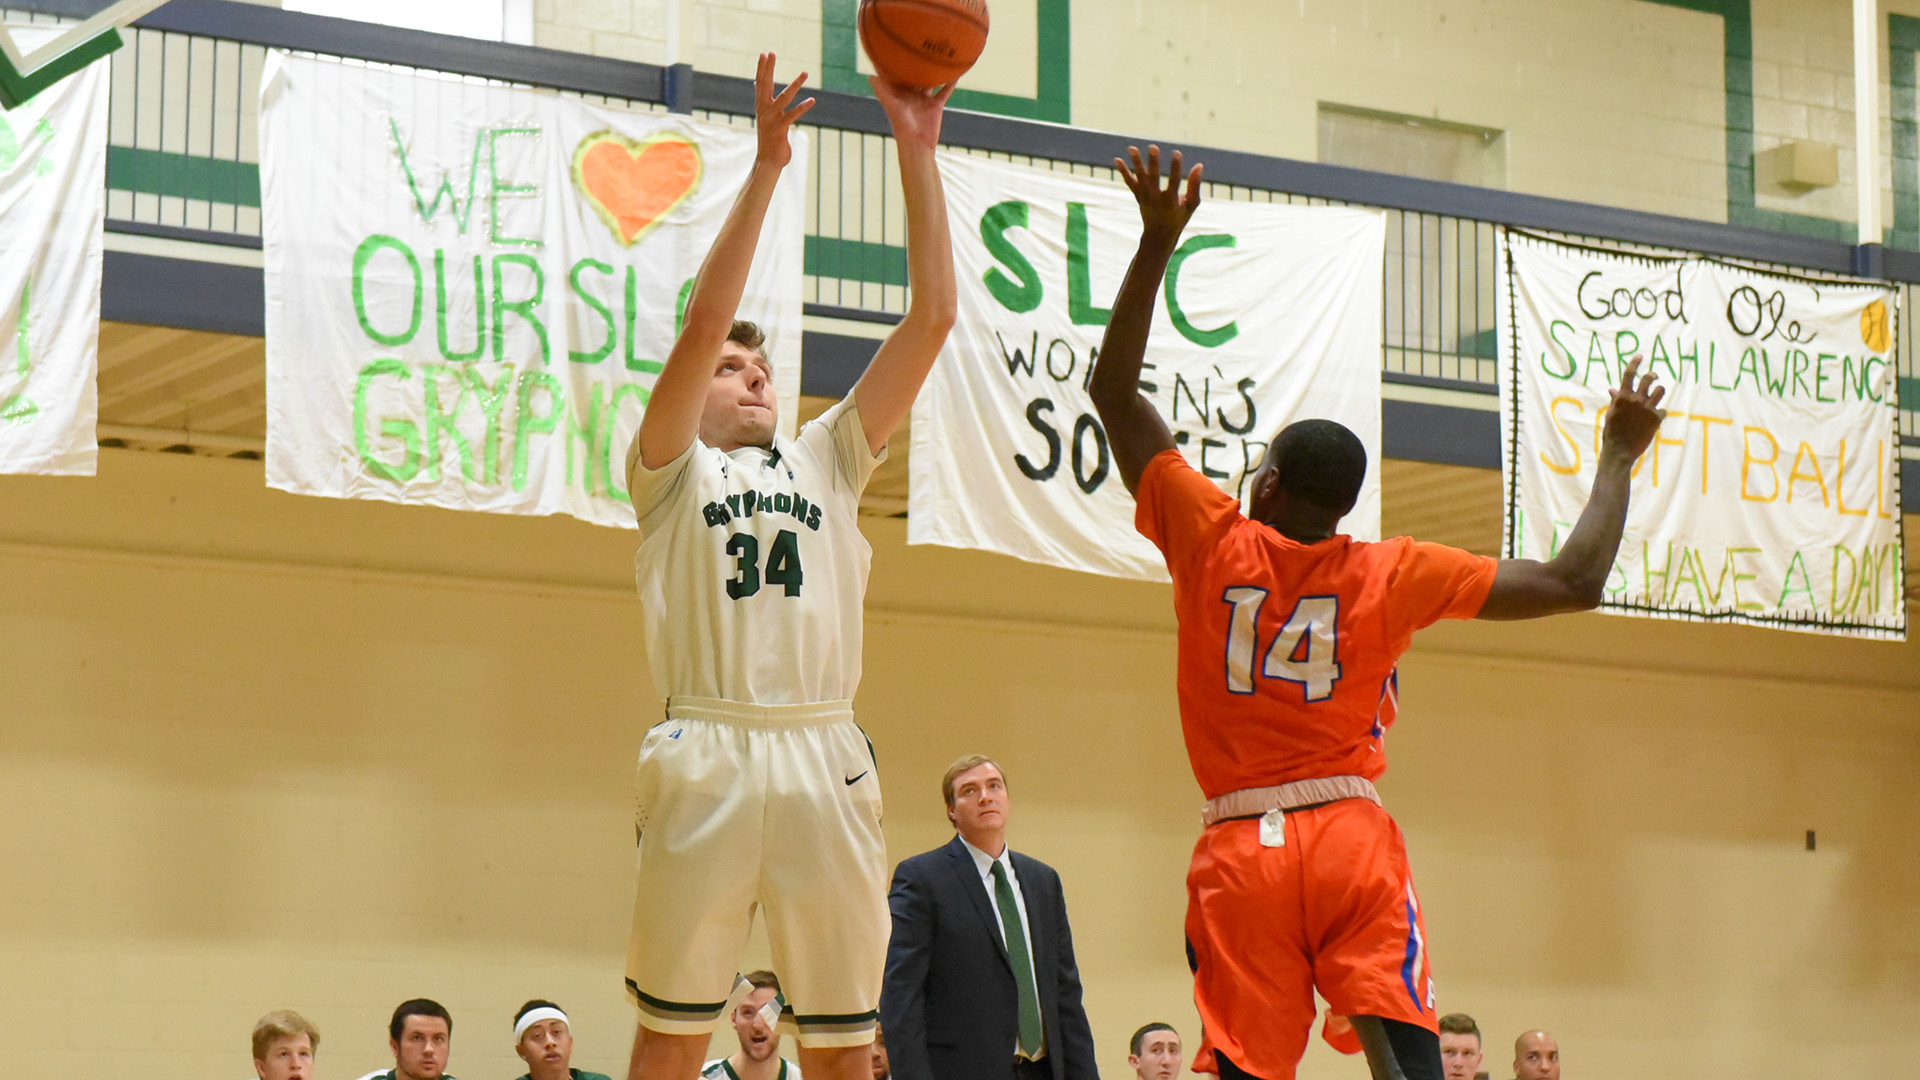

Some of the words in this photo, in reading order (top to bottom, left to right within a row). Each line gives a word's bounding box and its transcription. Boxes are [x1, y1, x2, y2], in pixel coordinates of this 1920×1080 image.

[388, 116, 546, 247] WE
[351, 233, 552, 366] OUR
[980, 200, 1240, 348] SLC
[1578, 264, 1689, 324] Good
[1541, 320, 1699, 387] SARAH
[352, 357, 652, 503] GRYPHO
[1014, 397, 1268, 510] SOER
[702, 489, 823, 532] GRYPHONS
[726, 529, 804, 600] 34
[1643, 540, 1764, 612] HAVE
[1778, 550, 1818, 612] A
[1830, 542, 1900, 617] DAY!
[1221, 585, 1342, 704] 14
